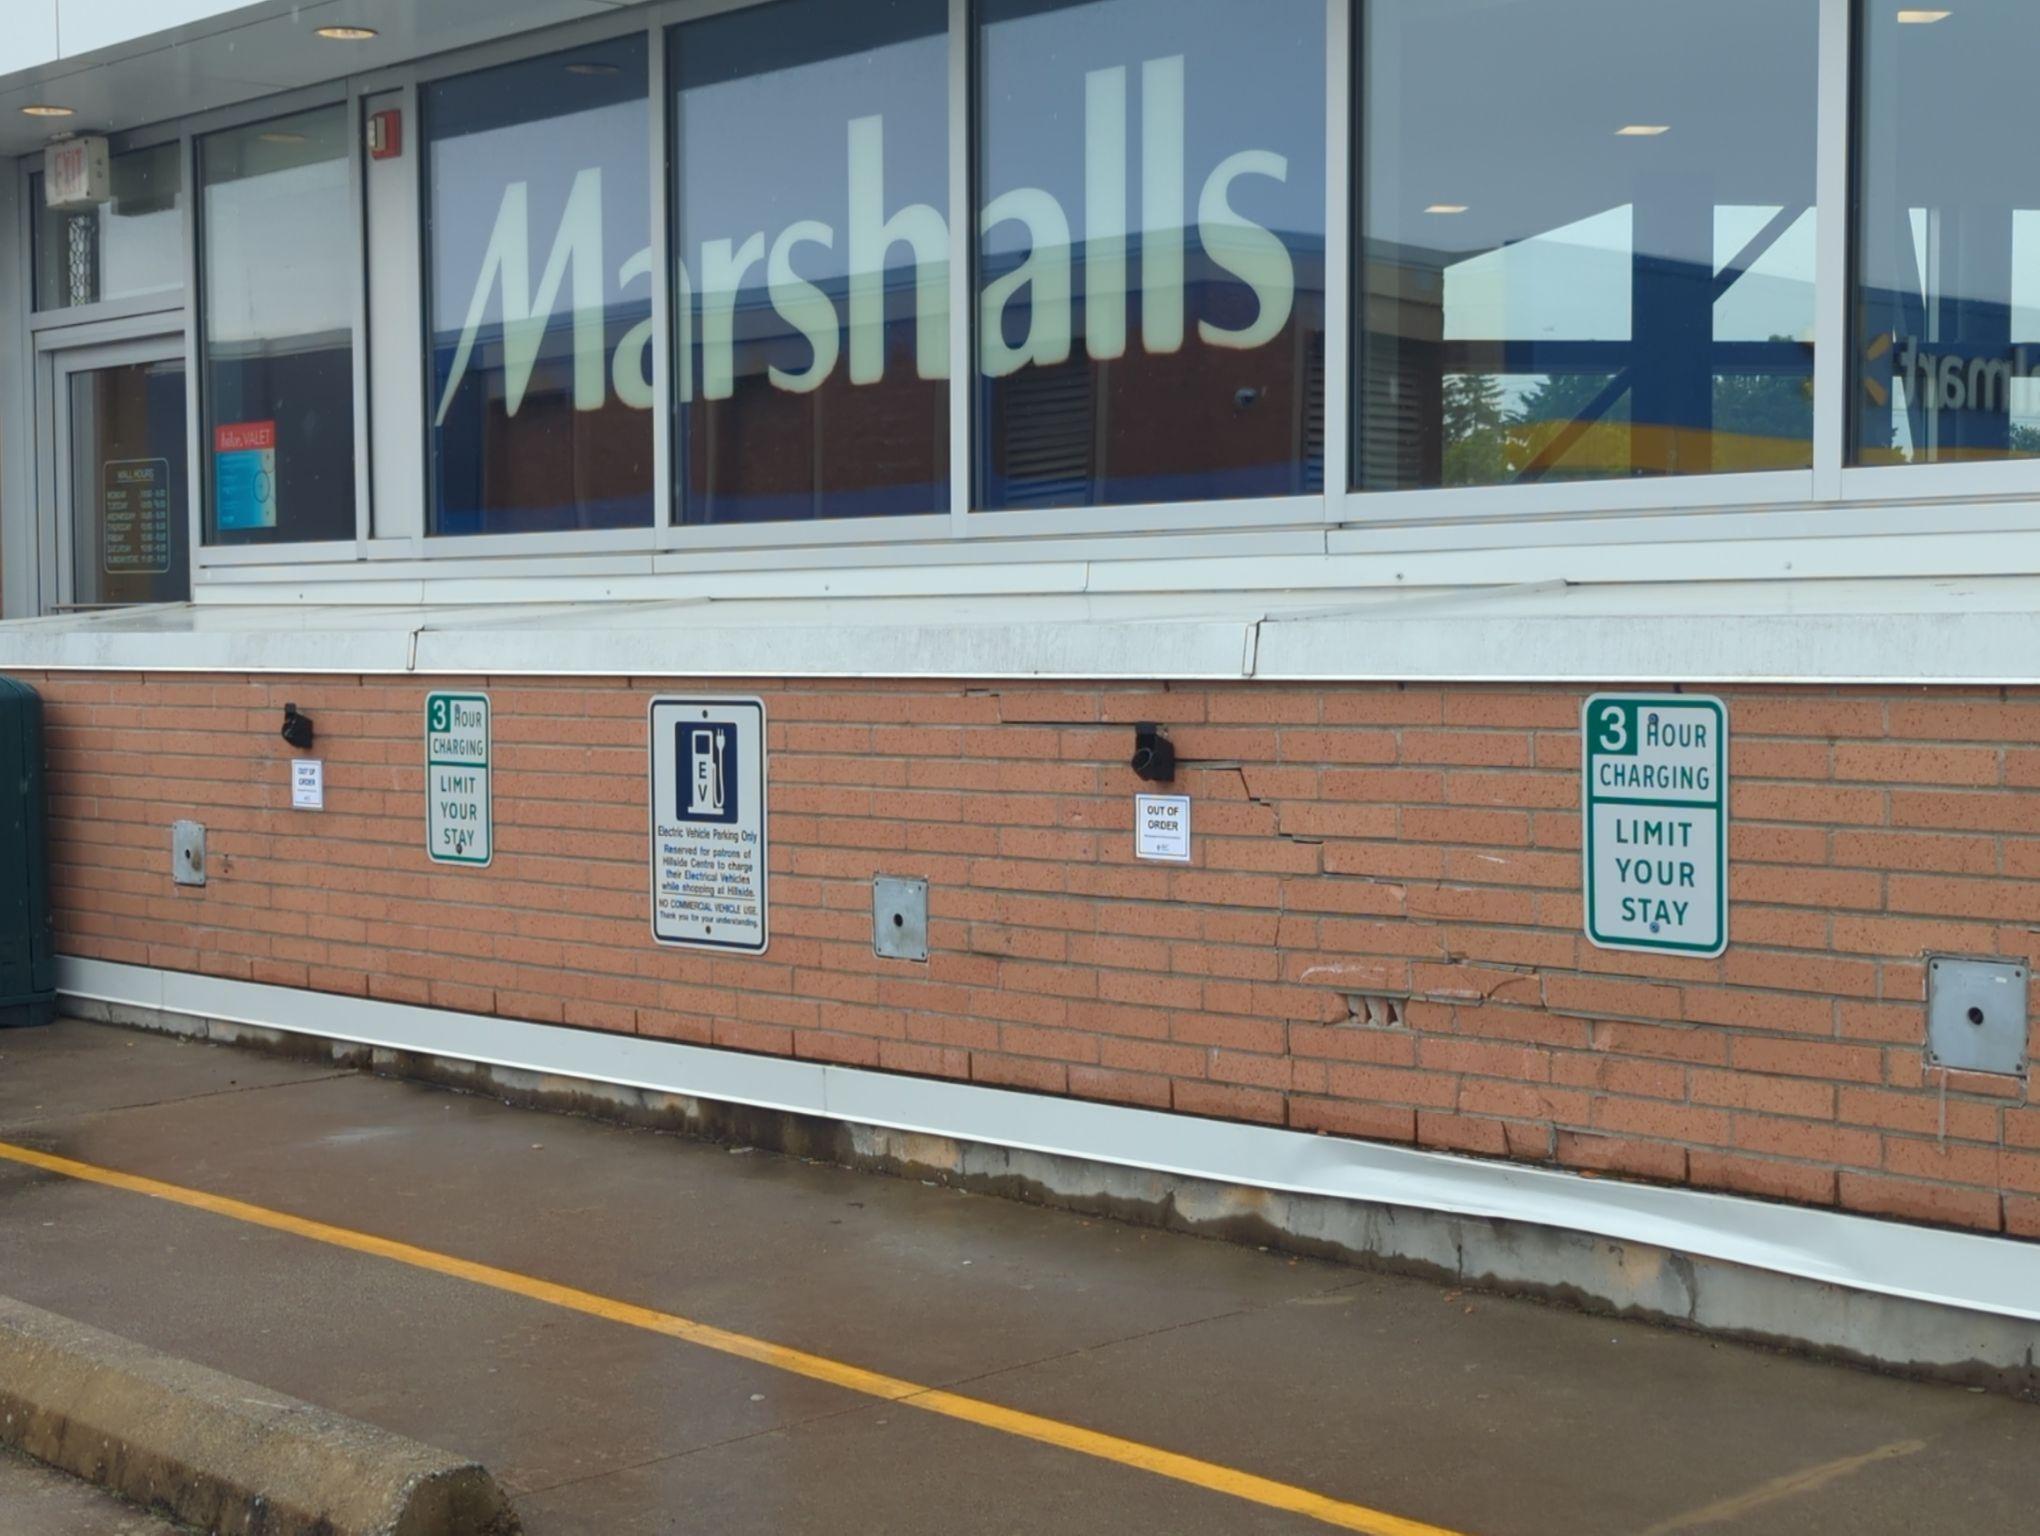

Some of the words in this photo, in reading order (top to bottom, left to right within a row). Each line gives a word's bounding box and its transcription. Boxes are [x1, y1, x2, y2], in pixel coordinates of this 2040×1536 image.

[435, 55, 1295, 427] Marshalls
[432, 700, 446, 730] 3
[454, 709, 482, 728] HOUR
[1600, 705, 1627, 751] 3
[1647, 720, 1707, 748] HOUR
[433, 738, 483, 756] CHARGING
[440, 775, 476, 794] LIMIT
[1600, 763, 1710, 790] CHARGING
[441, 802, 477, 820] YOUR
[1147, 805, 1165, 816] OUT
[1167, 806, 1179, 817] OF
[1147, 819, 1179, 831] ORDER
[1616, 818, 1692, 847] LIMIT
[444, 828, 475, 846] STAY
[658, 825, 684, 838] Electric
[686, 827, 710, 840] Vehicle
[713, 828, 739, 843] Parking
[741, 830, 757, 844] Only
[664, 844, 697, 855] Reserved
[700, 846, 710, 856] for
[713, 847, 741, 858] patrons
[743, 849, 752, 859] of
[663, 857, 688, 867] Hillside
[690, 858, 715, 869] Centre
[717, 860, 726, 870] to
[728, 861, 753, 874] charge
[1615, 858, 1695, 888] YOUR
[666, 869, 682, 879] their
[684, 870, 718, 881] Electrical
[720, 872, 751, 885] Vehicles
[662, 881, 680, 891] while
[682, 882, 715, 897] shopping
[717, 885, 725, 895] at
[659, 899, 669, 908] NO
[670, 900, 712, 912] COMMERCIAL
[714, 903, 741, 914] VEHICLE
[1621, 897, 1689, 926] STAY
[660, 911, 676, 919] Thank
[701, 915, 714, 923] your
